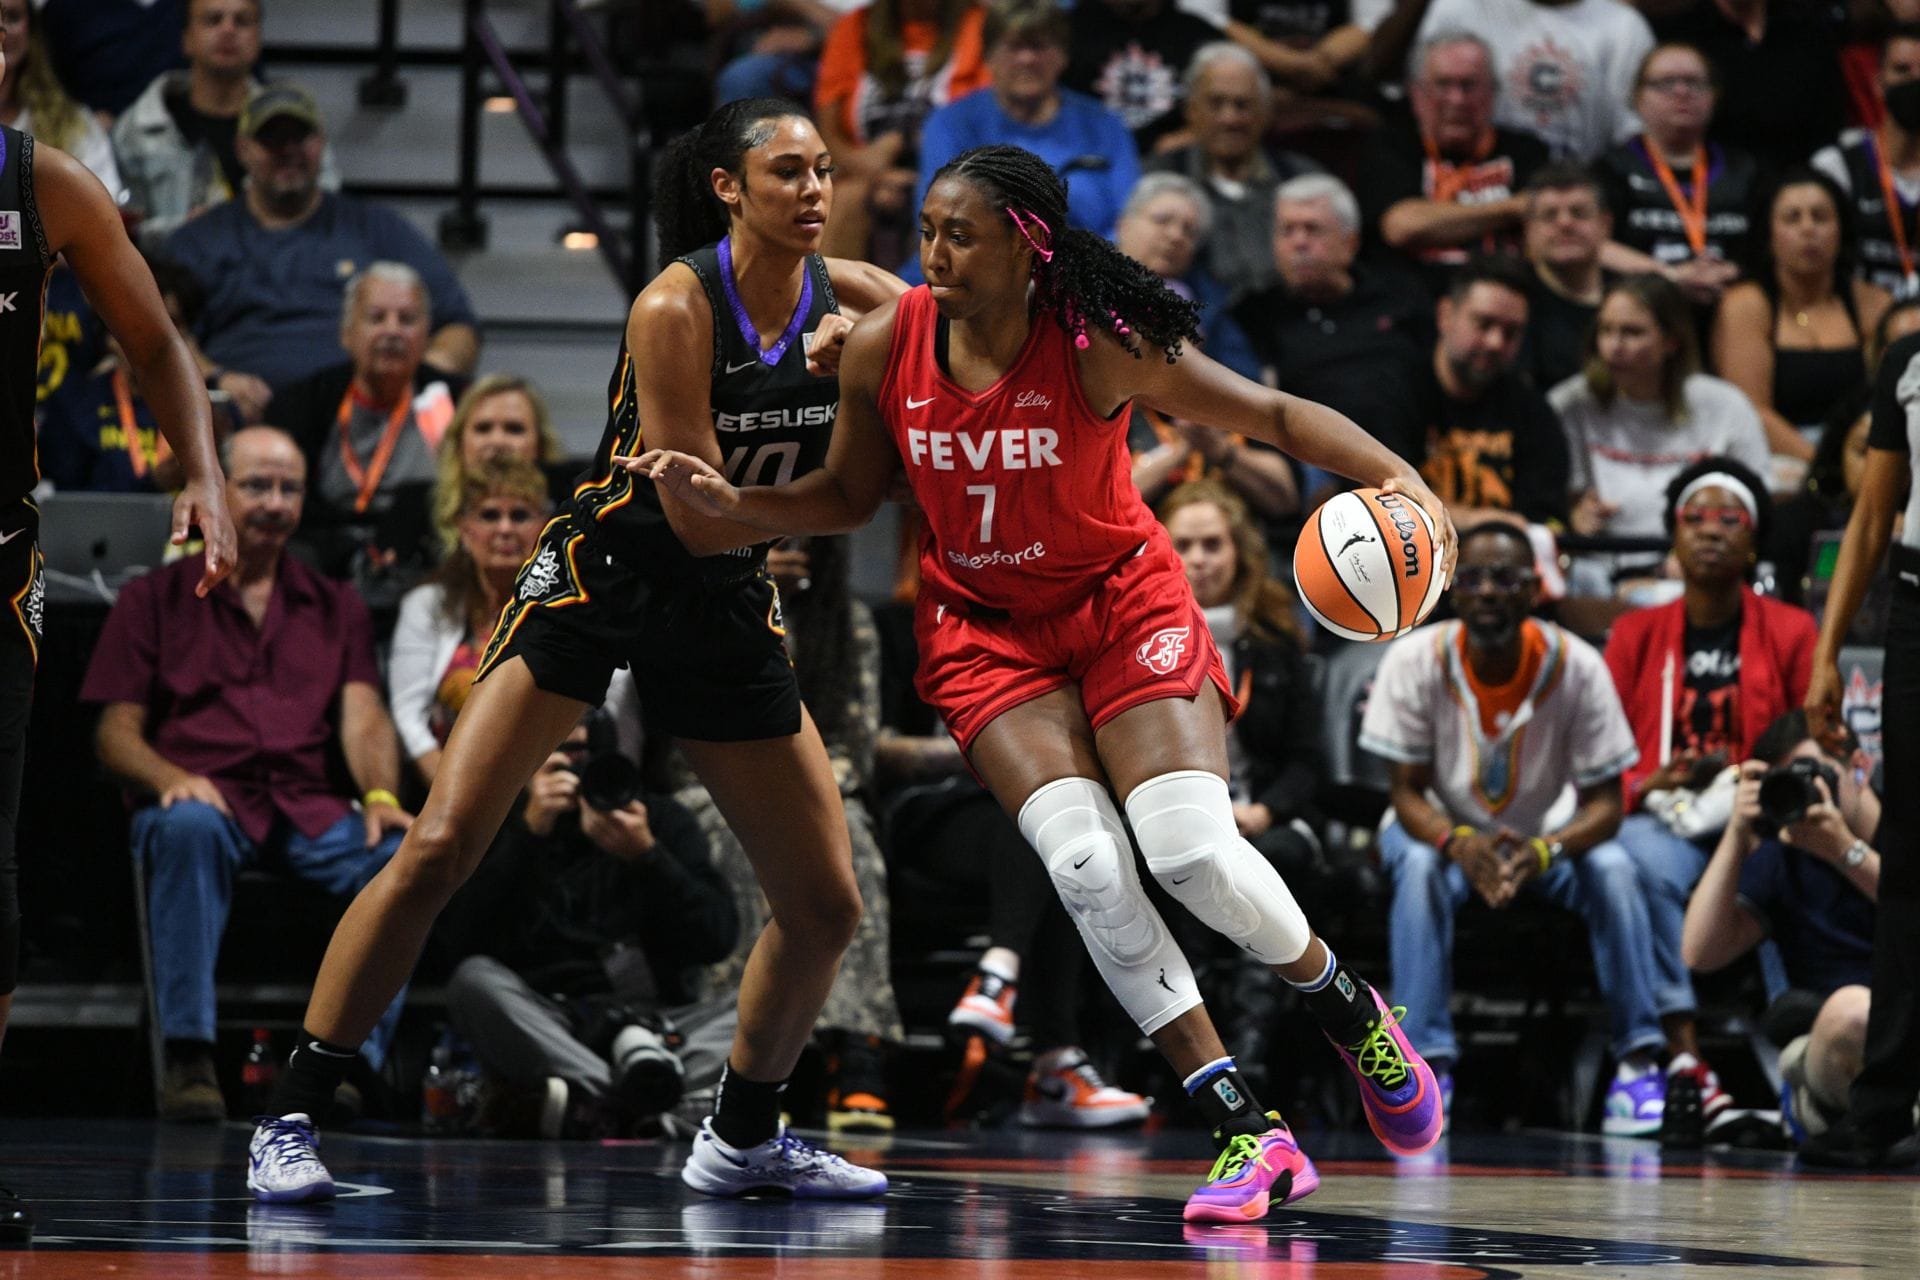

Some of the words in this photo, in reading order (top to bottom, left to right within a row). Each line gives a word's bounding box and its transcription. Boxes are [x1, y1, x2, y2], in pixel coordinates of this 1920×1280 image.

[712, 402, 838, 432] EESUSK
[1014, 390, 1052, 411] Lilly
[907, 427, 1063, 471] FEVER
[966, 484, 996, 543] 7
[1375, 492, 1420, 578] Wilson
[948, 541, 1046, 570] salesforce
